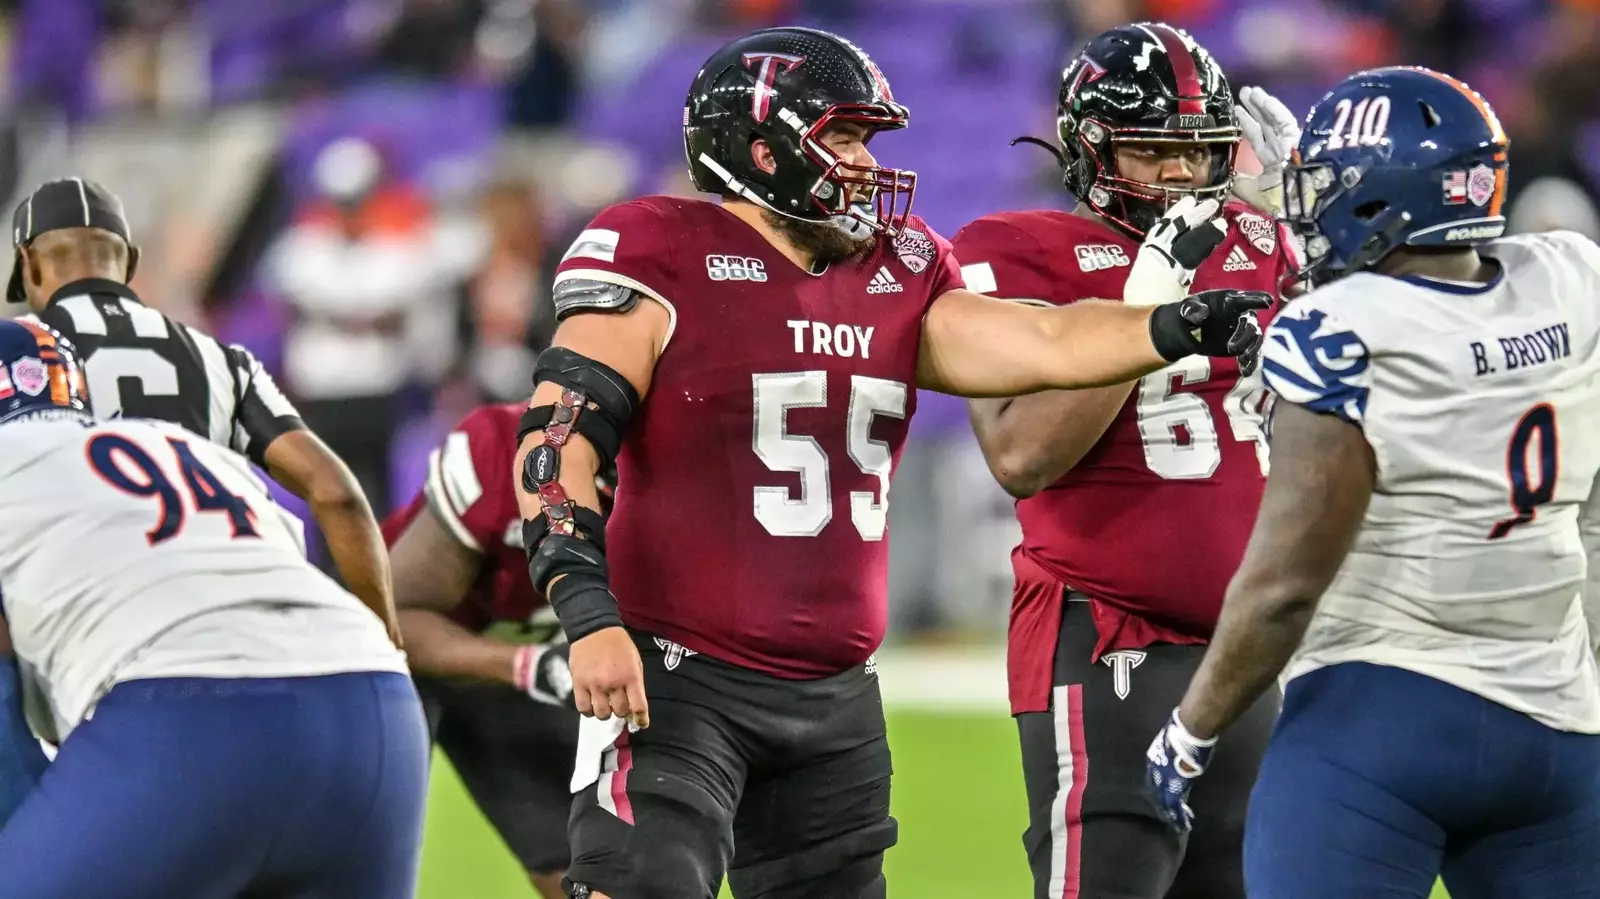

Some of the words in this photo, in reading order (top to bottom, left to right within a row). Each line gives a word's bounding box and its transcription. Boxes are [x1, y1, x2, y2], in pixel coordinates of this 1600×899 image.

[1180, 114, 1207, 128] TROY
[1326, 95, 1391, 151] 210
[706, 254, 768, 282] SBC
[1074, 244, 1130, 272] SBC
[1222, 260, 1257, 272] adidas
[866, 282, 904, 294] adidas
[786, 319, 875, 360] TROY
[1469, 341, 1496, 376] B.
[1498, 322, 1571, 371] BROWN
[751, 370, 908, 542] 55
[1487, 402, 1559, 540] 9
[84, 432, 264, 547] 94
